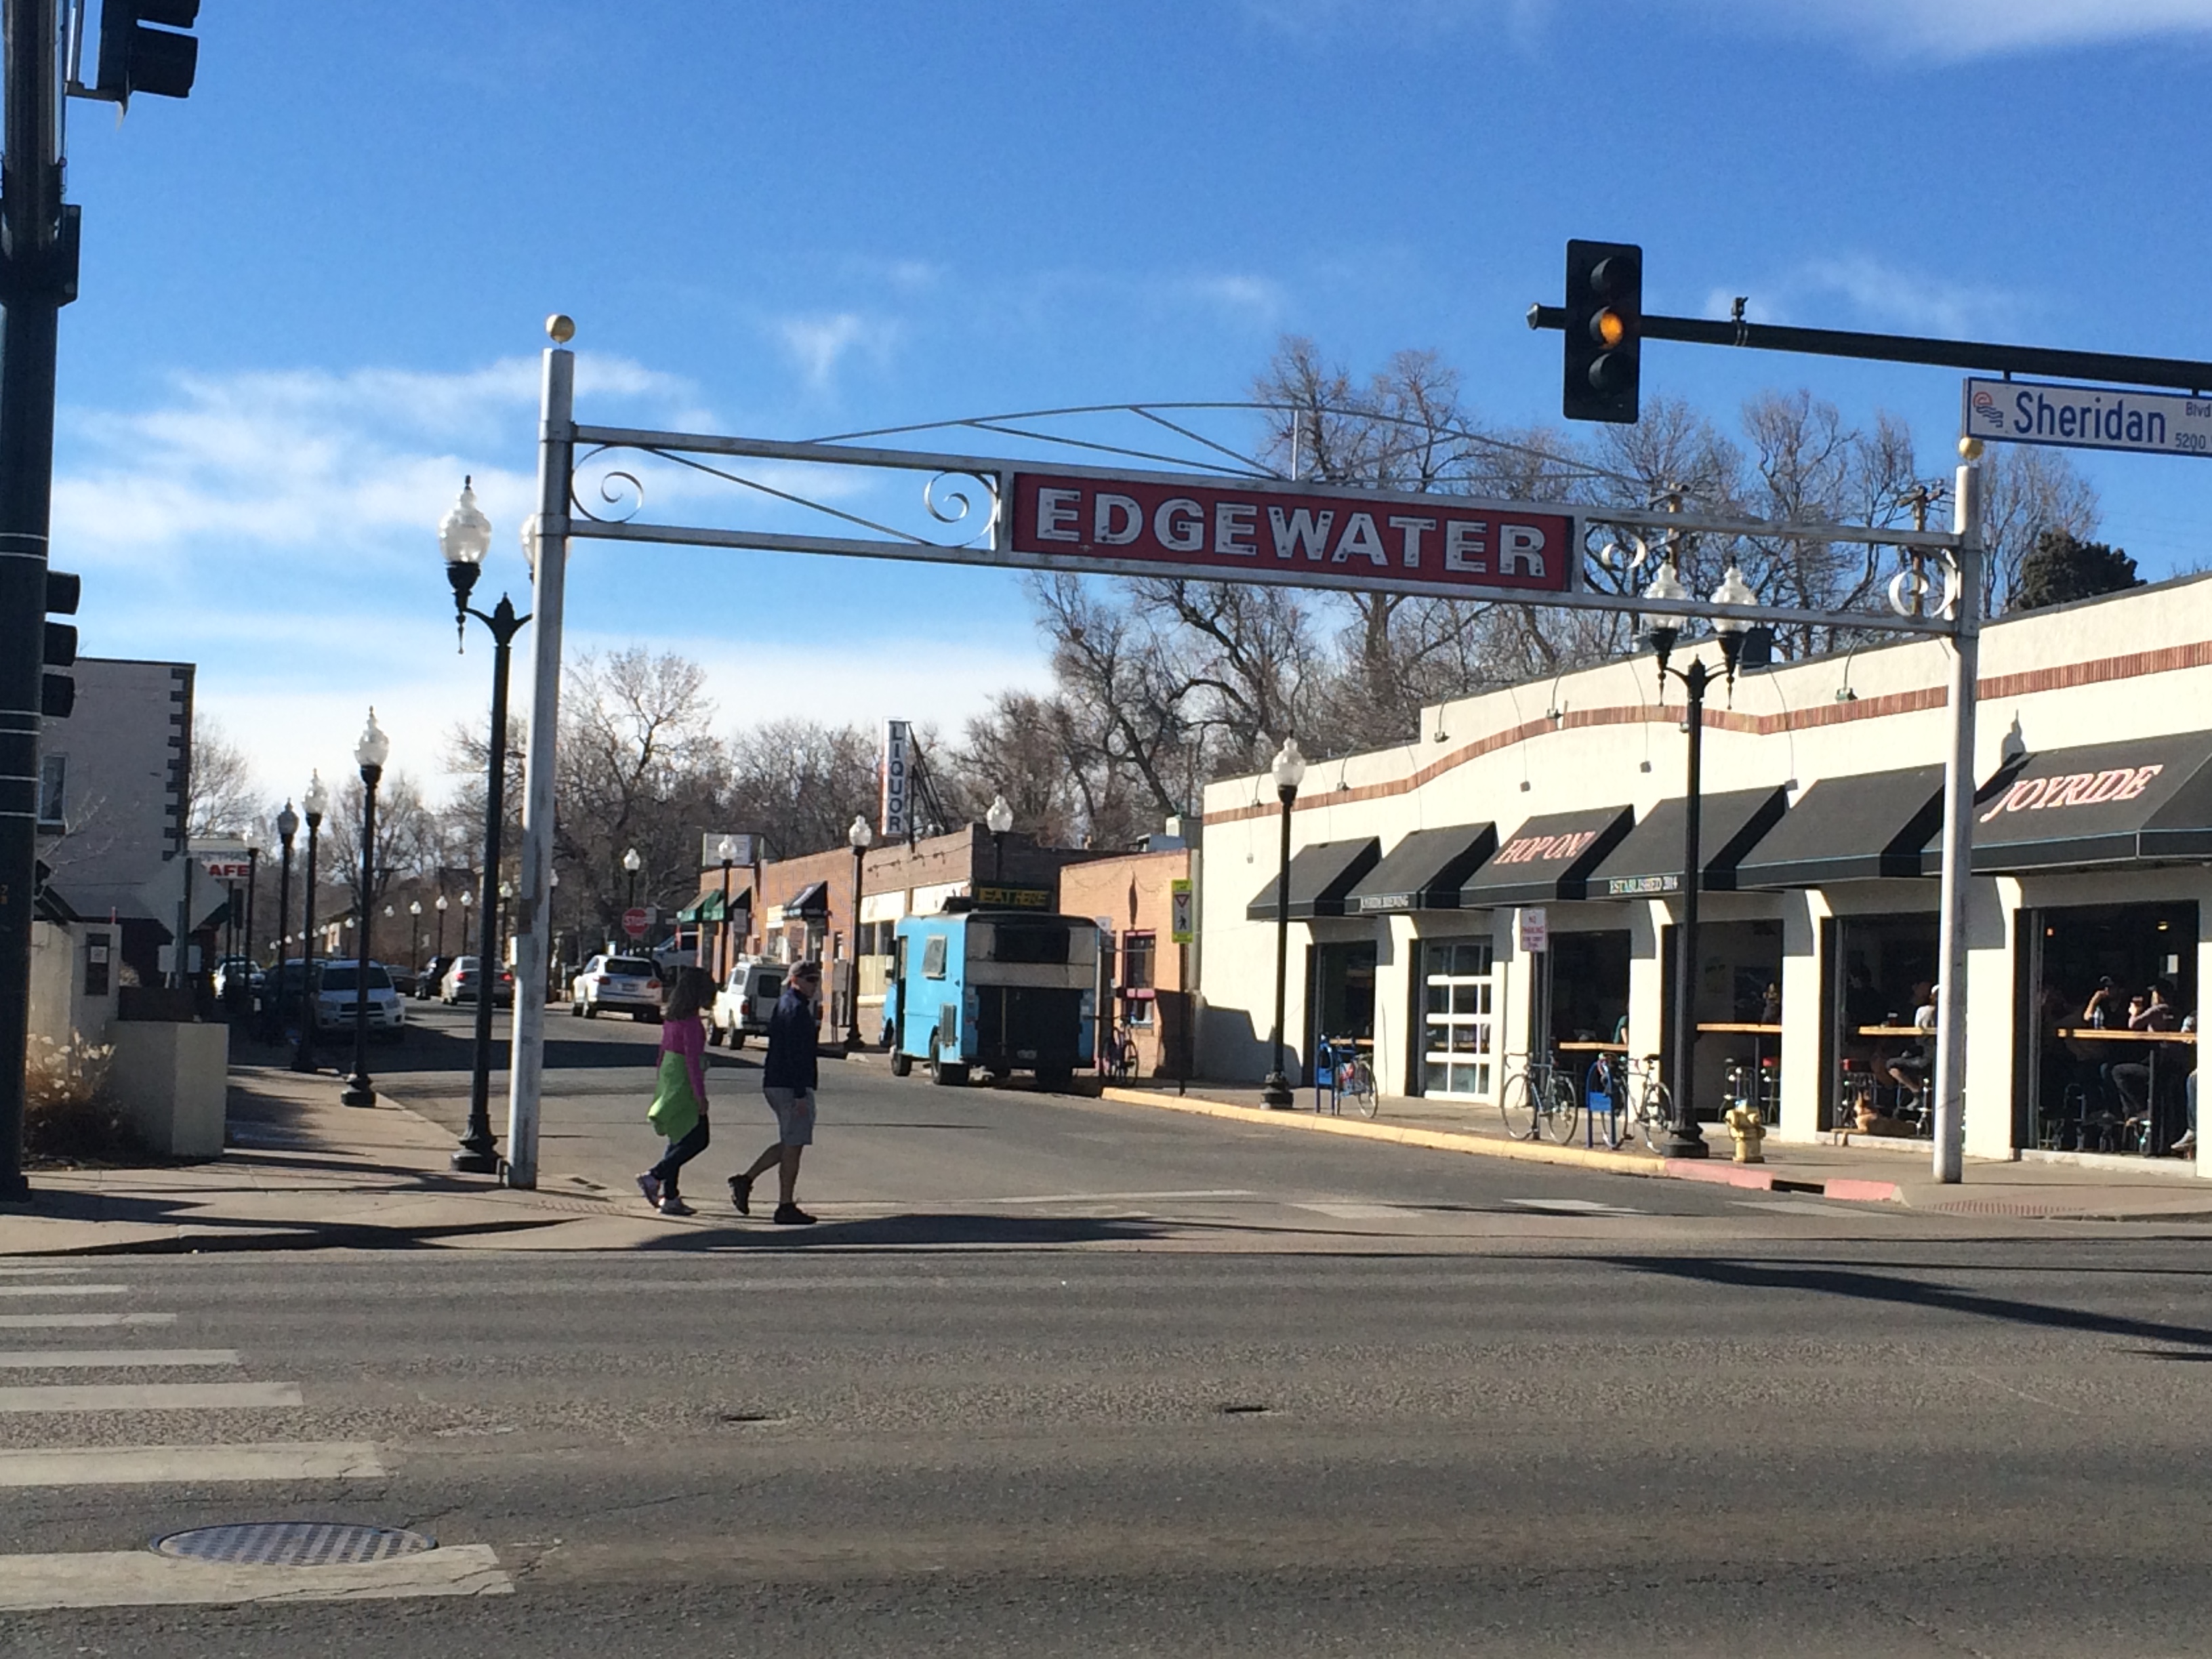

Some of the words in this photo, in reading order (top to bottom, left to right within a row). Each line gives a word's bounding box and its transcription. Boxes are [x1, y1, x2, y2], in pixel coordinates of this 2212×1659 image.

[2014, 391, 2166, 444] Sheridan
[2186, 401, 2211, 417] Blvd
[2175, 432, 2206, 450] 5200
[1036, 486, 1547, 578] EDGEWATER
[889, 726, 904, 832] LIQUOR
[1980, 764, 2164, 823] JOYRIDE
[209, 864, 250, 876] AFE
[1493, 836, 1555, 865] HOP
[1609, 877, 1662, 895] ESTABLISHED
